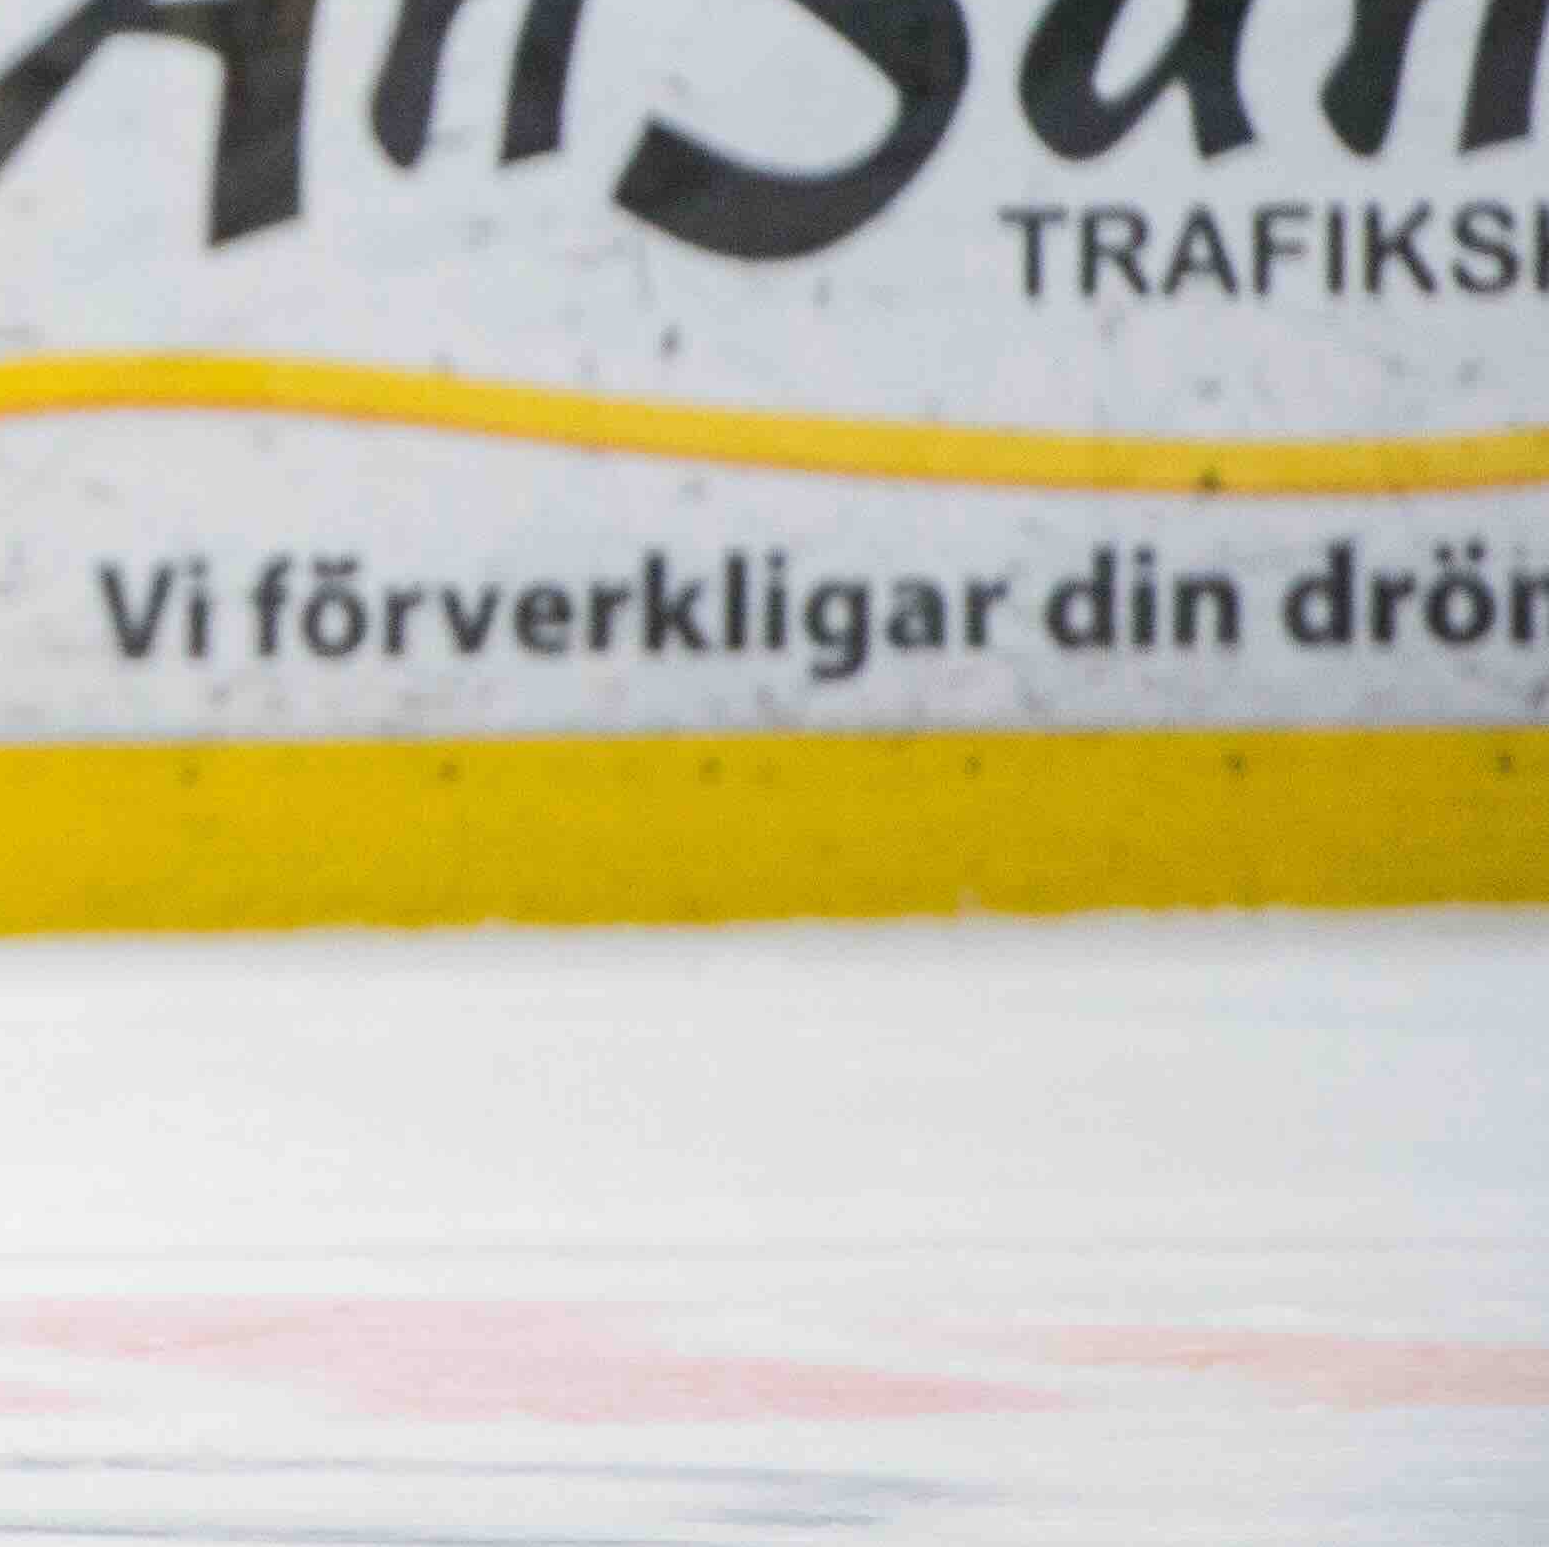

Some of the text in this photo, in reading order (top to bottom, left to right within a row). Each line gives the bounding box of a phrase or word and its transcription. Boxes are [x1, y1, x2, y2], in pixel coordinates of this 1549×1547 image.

[997, 200, 1549, 298] TRAFIKS
[99, 551, 210, 659] Vi
[254, 547, 1007, 685] förverkligar
[1045, 541, 1240, 649] din
